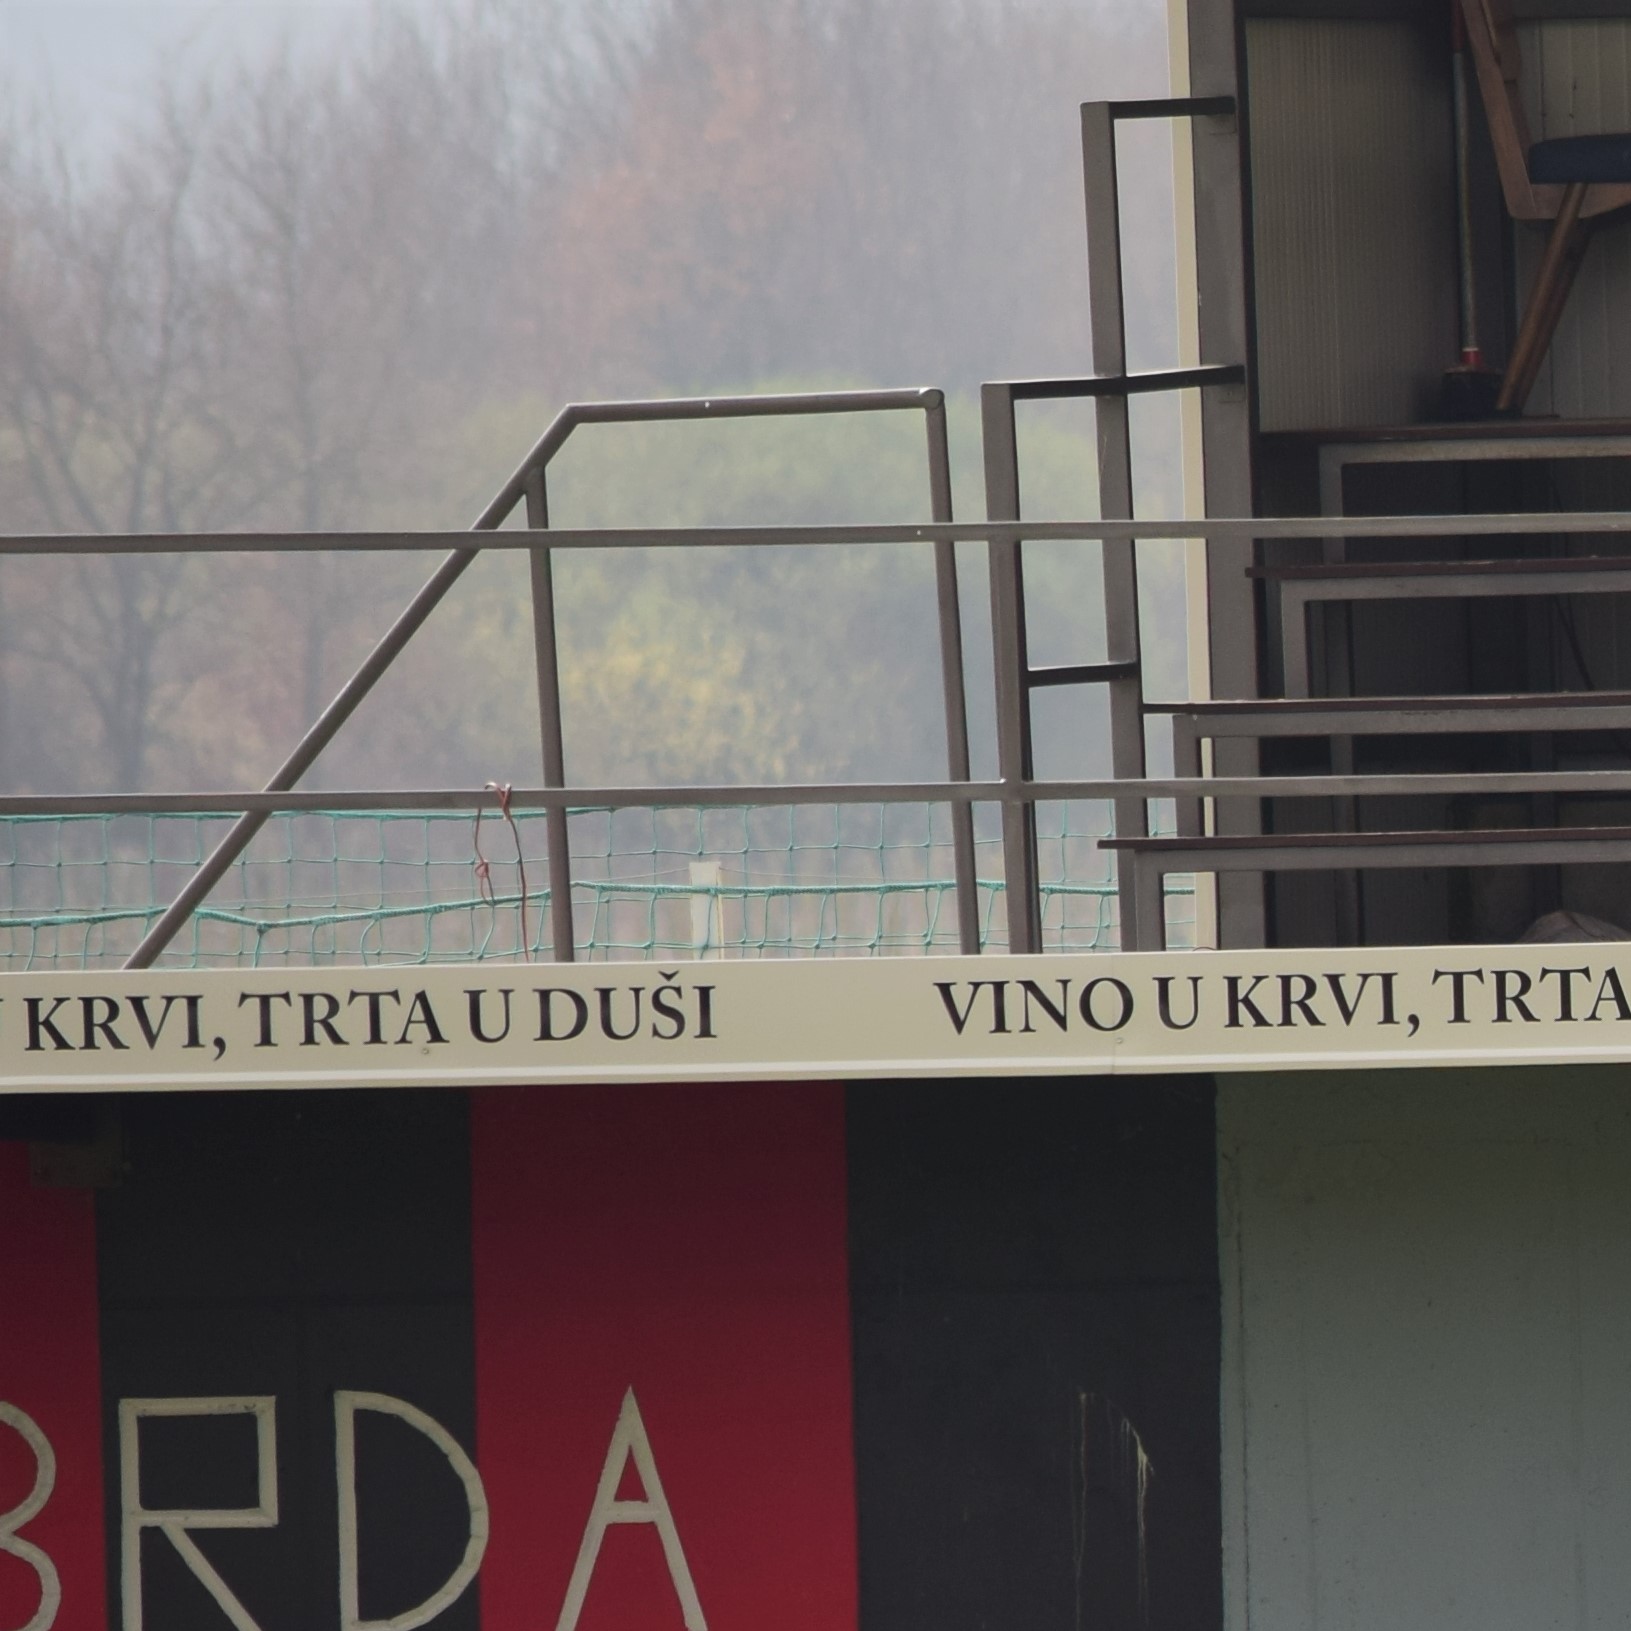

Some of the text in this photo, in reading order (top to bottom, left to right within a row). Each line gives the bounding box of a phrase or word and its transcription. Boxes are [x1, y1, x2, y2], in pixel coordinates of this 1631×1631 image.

[22, 970, 718, 1061] KRVI, TRTA U DUŠI
[932, 976, 1134, 1035] VINO
[1152, 975, 1204, 1030] U
[1222, 972, 1420, 1038] KRVI,
